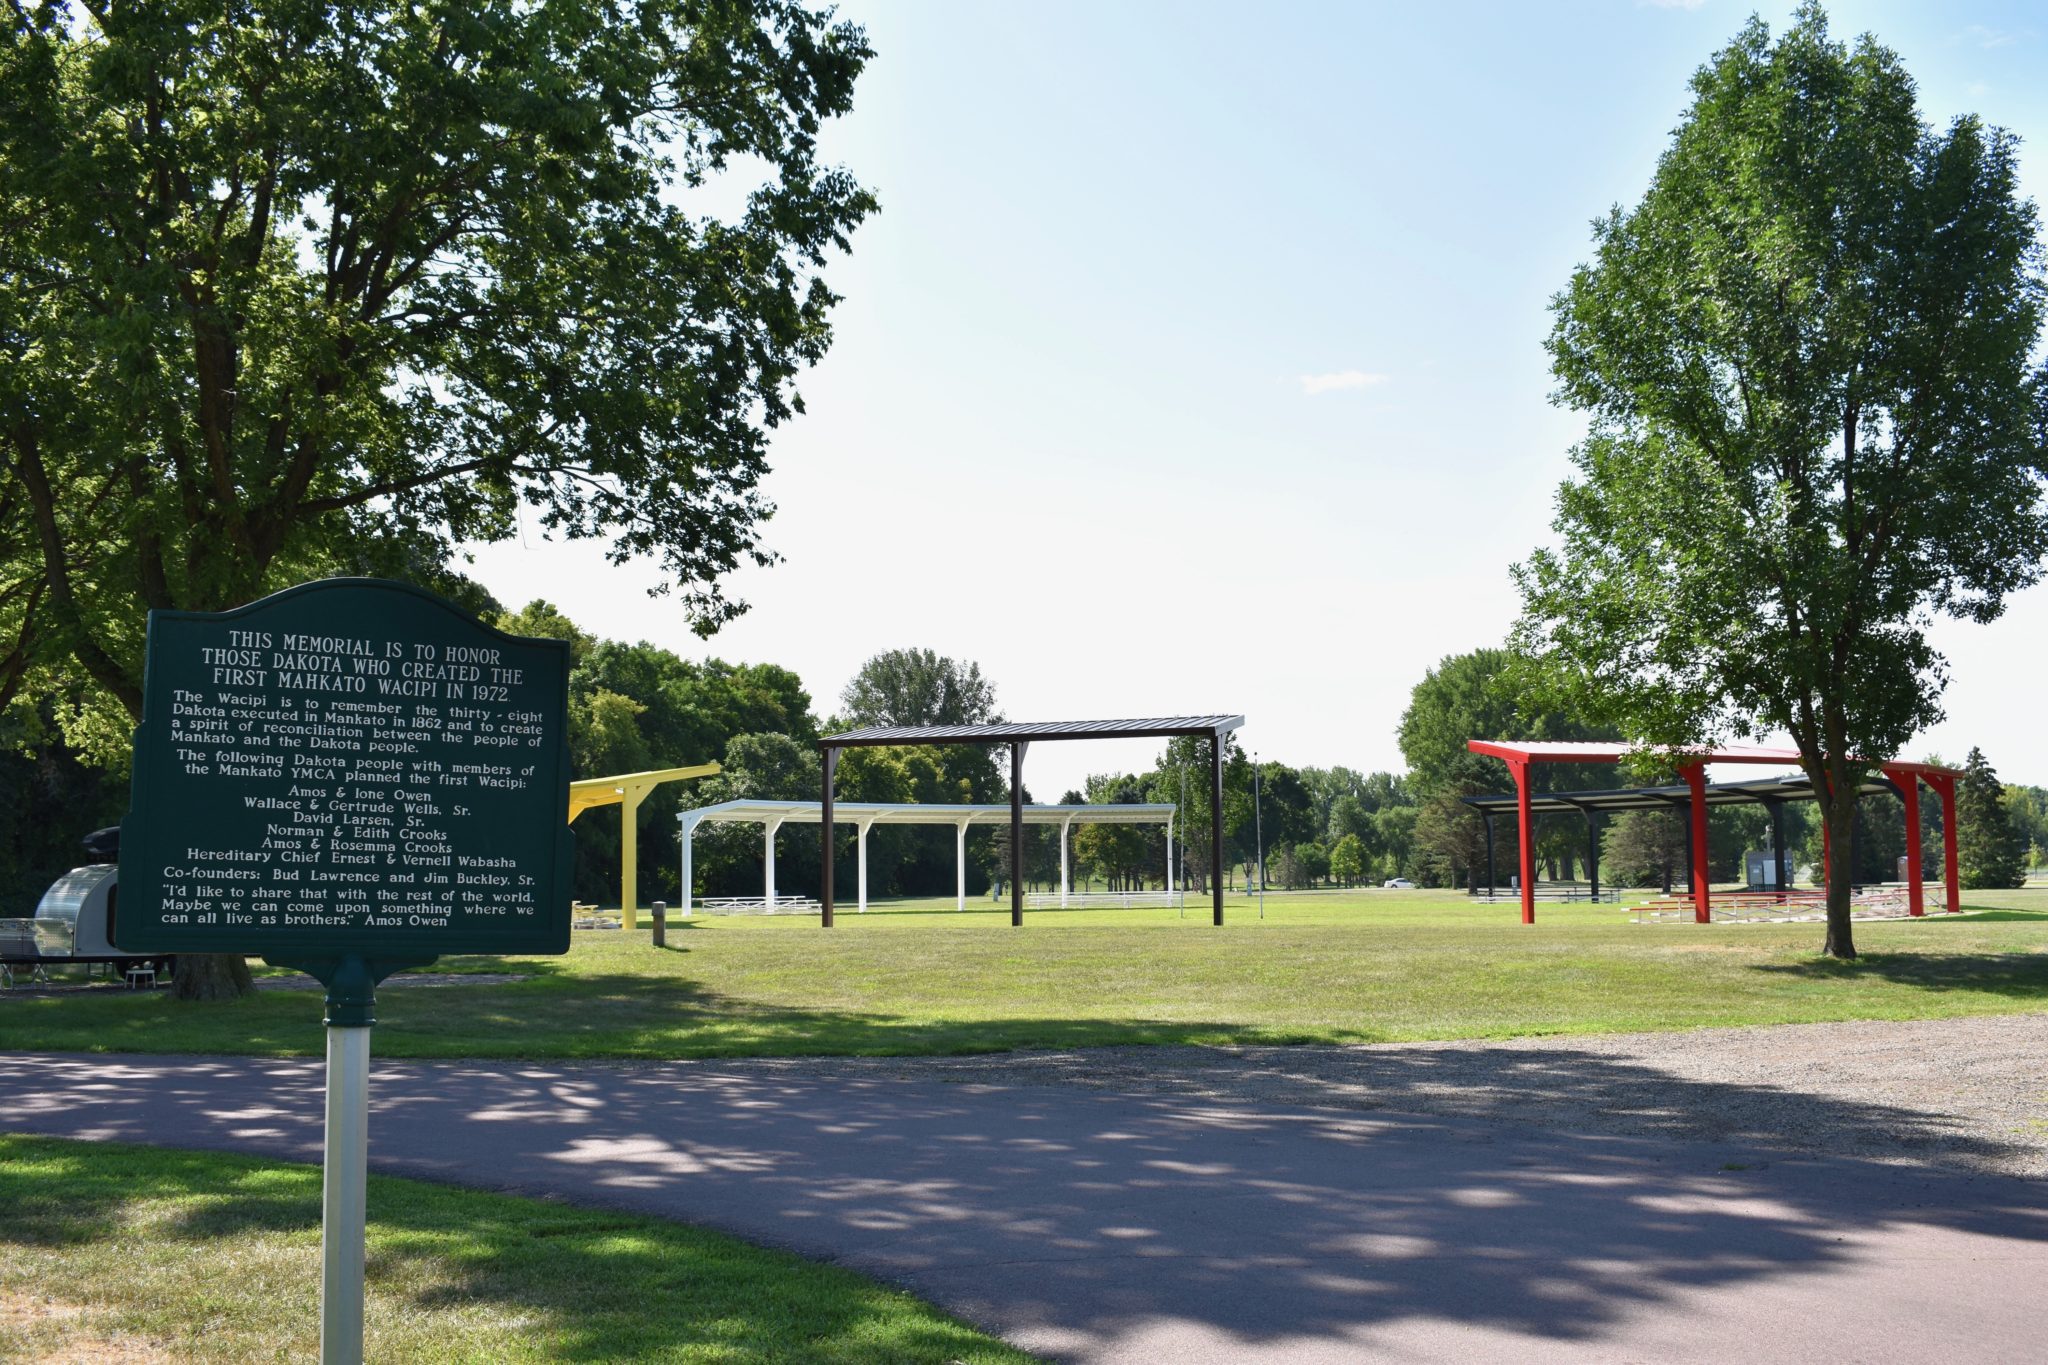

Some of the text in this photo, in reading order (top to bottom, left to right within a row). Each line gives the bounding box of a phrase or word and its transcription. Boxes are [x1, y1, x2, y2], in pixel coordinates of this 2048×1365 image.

[229, 630, 500, 665] THIS MEMORIAL IS TO HONOR
[202, 648, 522, 684] THOSE DAKOTA WHO CREATED THE
[213, 667, 267, 687] FIRST
[278, 671, 366, 693] MAHKATO
[378, 679, 437, 697] WACIPI
[446, 683, 463, 699] IN
[173, 690, 203, 703] The
[218, 693, 266, 707] Wacipi
[281, 696, 292, 707] is
[305, 699, 319, 709] to
[331, 702, 402, 714] remember
[416, 704, 437, 716] the
[173, 703, 543, 735] Dakota executed in Mankato in 1862 and to create
[170, 730, 419, 754] Mankato and the Dakota people.
[171, 718, 542, 747] a spirit of reconciliation between the people of
[176, 749, 535, 776] The following Dakota people with members of
[185, 763, 526, 790] the Mankato YMCA planned the first Wacipi:
[288, 785, 431, 802] Amos & Ione Owen
[244, 796, 301, 810] Wallace
[309, 799, 319, 810] &
[329, 800, 394, 813] Gertrude
[453, 805, 471, 816] Sr.
[293, 811, 333, 824] David
[406, 815, 425, 827] Sr.
[267, 824, 447, 840] Norman & Edith Crooks
[261, 836, 452, 853] Amos & Rosemma Crooks
[187, 848, 516, 868] Hereditary Chief Ernest & Vernell Wabasha
[163, 866, 260, 879] Co-founders:
[273, 868, 299, 880] Bud
[310, 870, 380, 882] Lawrence
[389, 873, 414, 883] and
[424, 872, 448, 884] Jim
[518, 875, 535, 885] Sr.
[196, 885, 223, 897] like
[230, 887, 244, 897] to
[251, 886, 292, 898] share
[299, 888, 327, 899] that
[337, 888, 367, 900] with
[377, 889, 399, 900] the
[406, 891, 432, 901] rest
[441, 890, 455, 901] of
[461, 891, 483, 901] the
[492, 892, 534, 902] world.
[161, 898, 534, 917] Maybe we can come upon something where we
[161, 914, 188, 923] can
[197, 912, 217, 924] all
[226, 913, 253, 924] live
[261, 915, 276, 924] as
[364, 914, 402, 926] Amos
[409, 915, 447, 926] Owen
